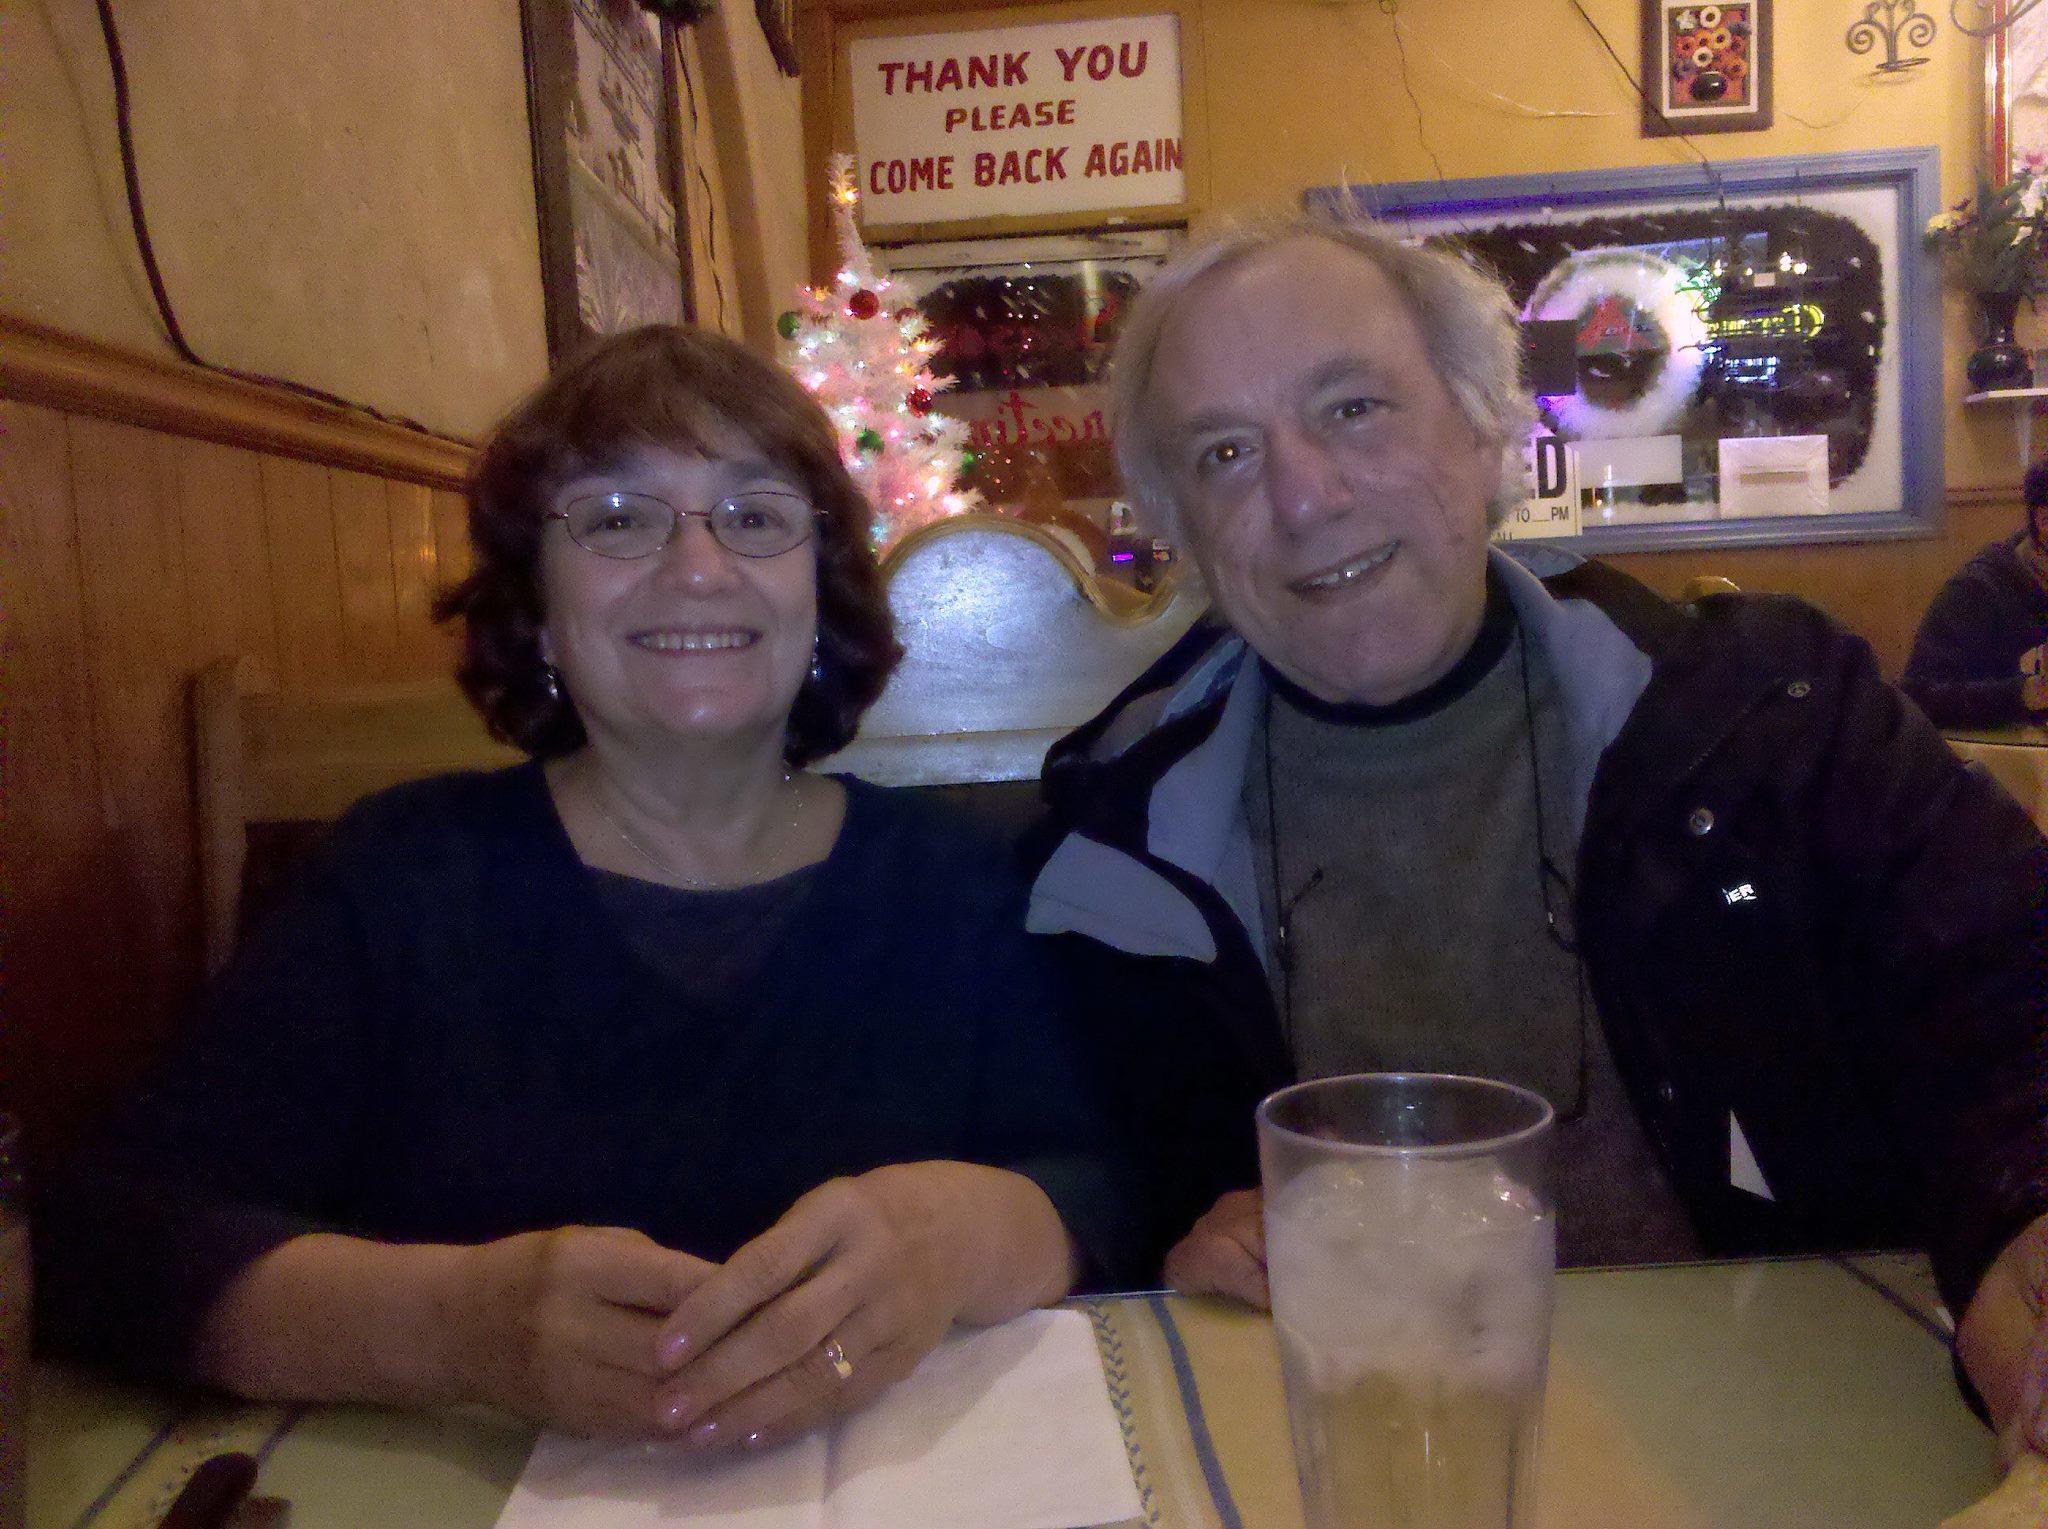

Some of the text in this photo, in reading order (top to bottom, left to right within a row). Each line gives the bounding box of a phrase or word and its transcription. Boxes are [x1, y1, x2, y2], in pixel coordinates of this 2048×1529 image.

[878, 41, 1148, 95] THANK YOU
[945, 99, 1075, 133] PLEASE
[869, 138, 1183, 195] COME BACK AGAIN
[1551, 506, 1569, 521] PM
